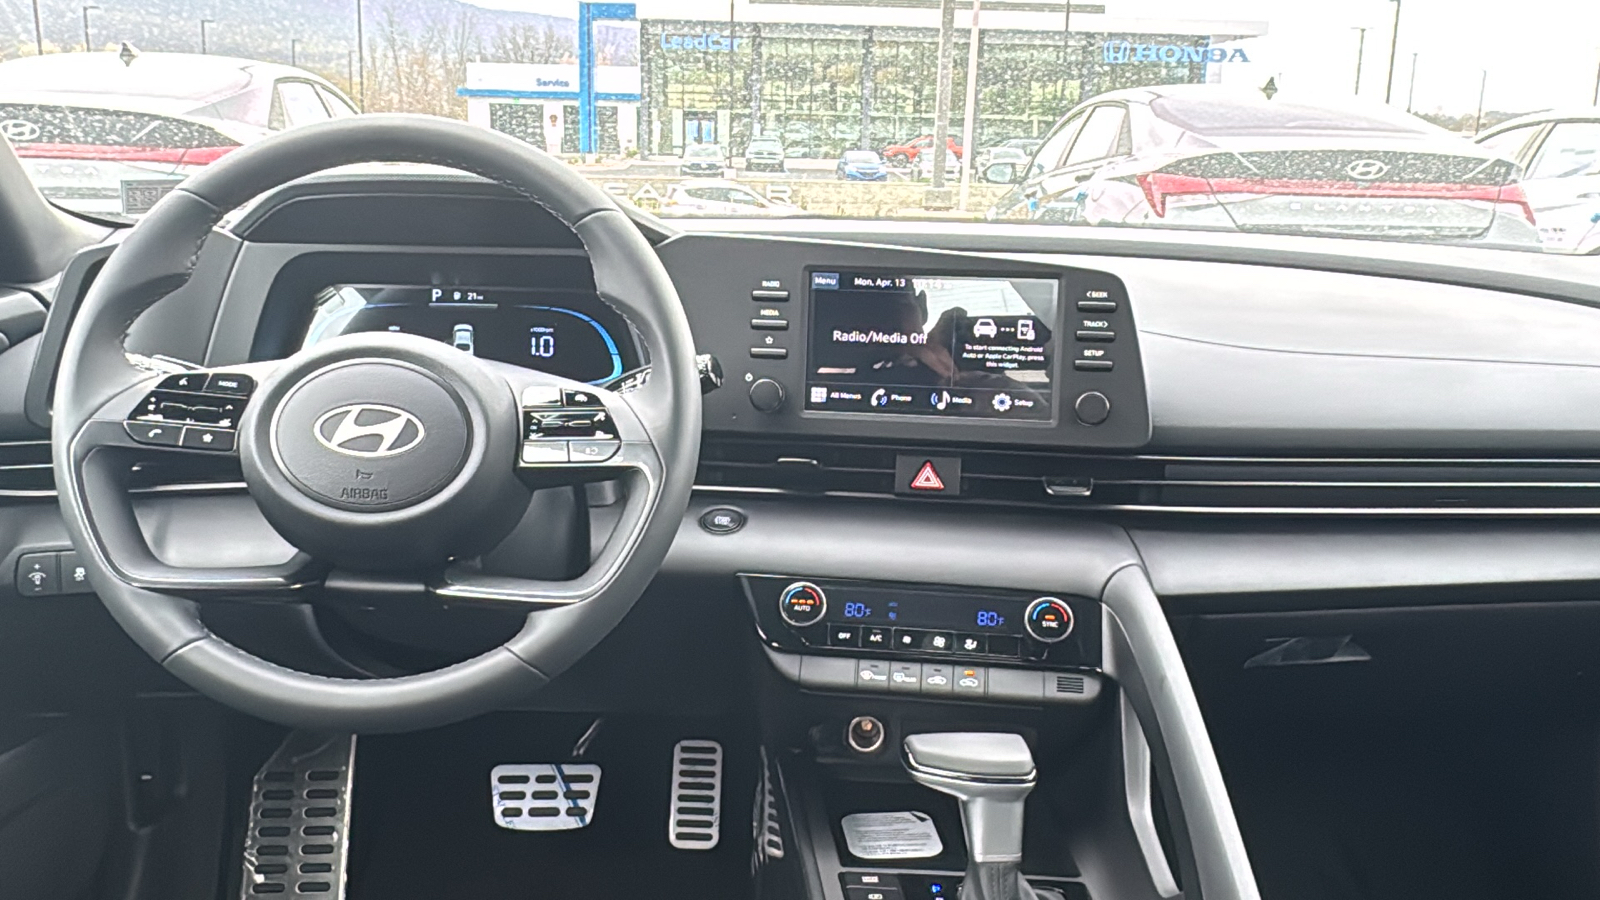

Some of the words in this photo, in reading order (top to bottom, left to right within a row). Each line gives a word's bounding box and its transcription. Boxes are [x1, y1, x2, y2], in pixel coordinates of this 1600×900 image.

[661, 31, 741, 51] LeadCar
[1133, 44, 1250, 63] HONDA
[536, 77, 569, 87] Service
[814, 276, 836, 285] Menu
[876, 278, 893, 288] Apr.
[895, 279, 906, 287] 13
[432, 288, 442, 302] P
[832, 330, 908, 345] Radio/Media
[910, 333, 928, 345] Off
[531, 335, 554, 357] 1.0
[1014, 399, 1034, 407] Setup
[340, 487, 389, 500] AIRBAG
[870, 634, 882, 642] A/C
